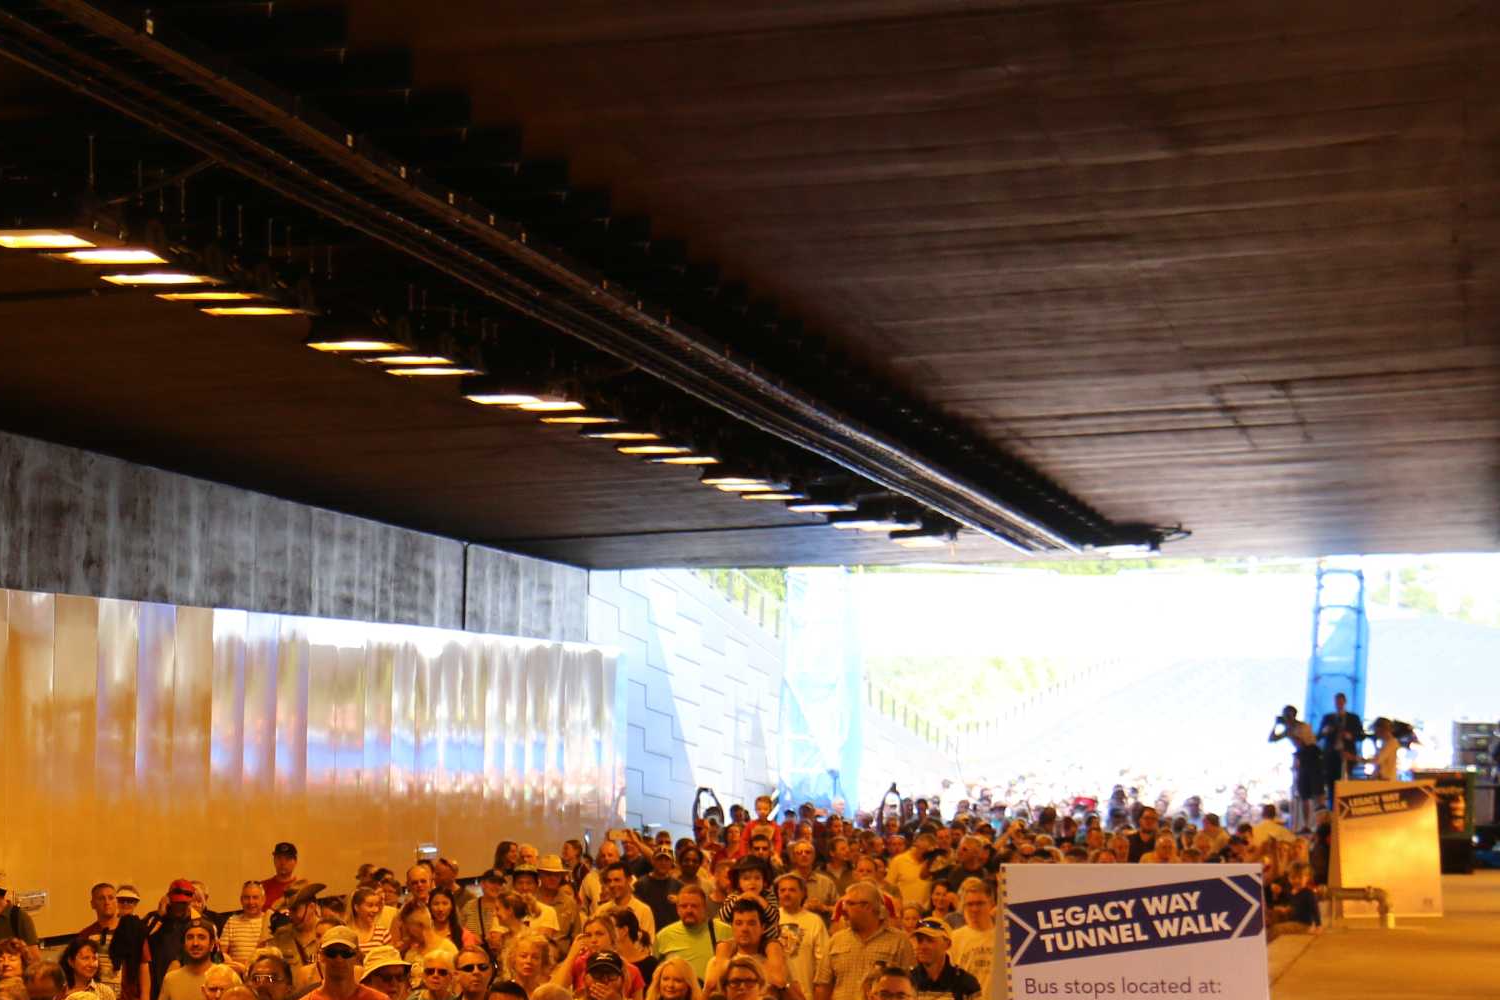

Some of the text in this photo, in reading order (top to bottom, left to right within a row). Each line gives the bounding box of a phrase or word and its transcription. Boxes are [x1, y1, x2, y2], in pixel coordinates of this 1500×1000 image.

[1036, 890, 1202, 930] LEGACY WAY
[1039, 911, 1232, 953] TUNNEL WALK
[1025, 976, 1222, 999] Bus stops located at:
